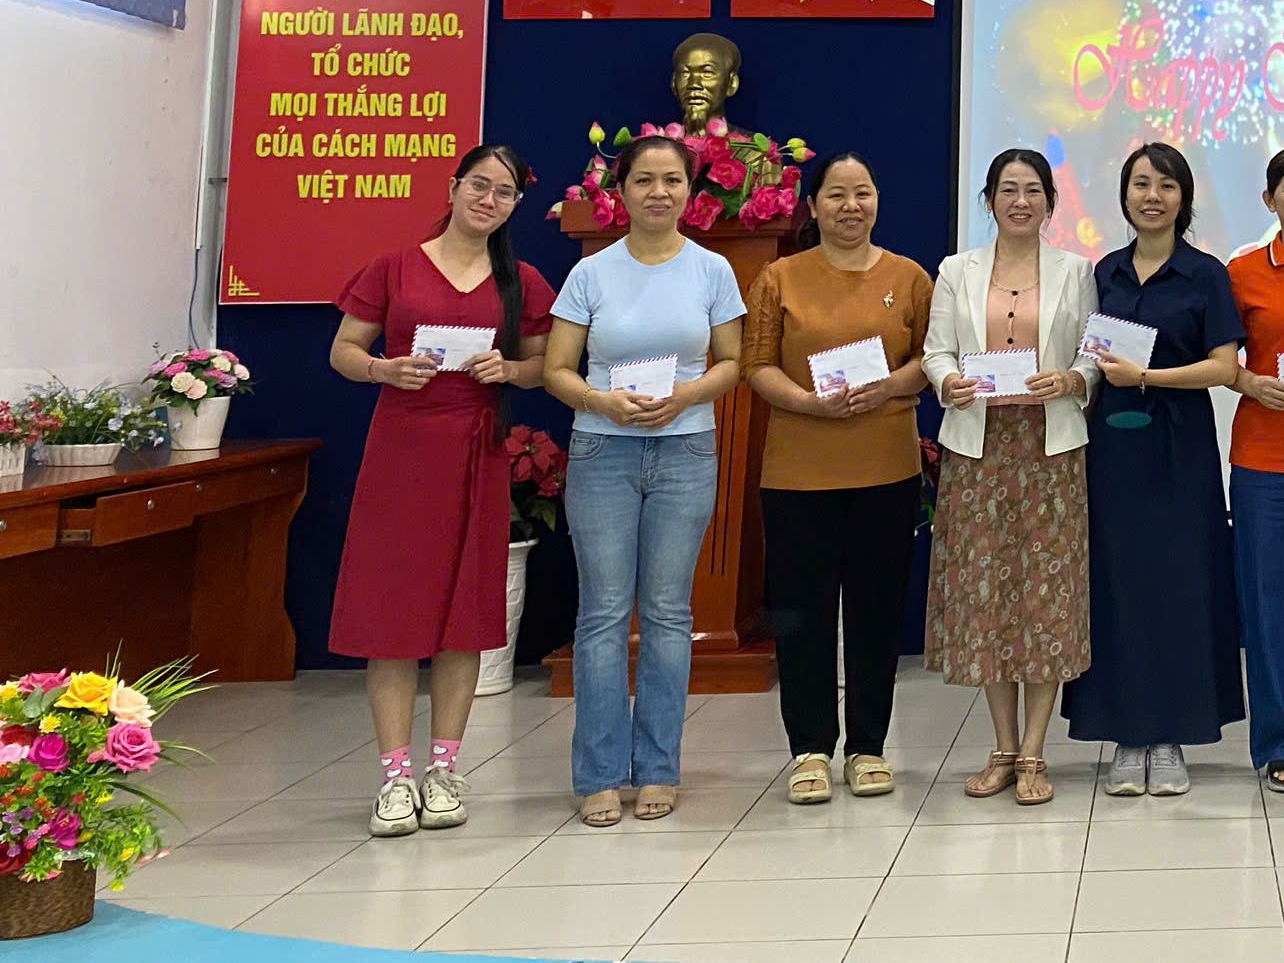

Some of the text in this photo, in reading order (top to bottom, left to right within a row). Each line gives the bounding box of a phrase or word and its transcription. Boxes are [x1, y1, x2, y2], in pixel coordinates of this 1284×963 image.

[260, 5, 464, 41] NGƯỜI LÃNH ĐẠO,
[312, 43, 411, 76] TỔ CHỨC
[1073, 17, 1246, 141] Happy
[270, 85, 447, 122] MỌI THẮNG LỢI
[256, 125, 456, 162] CỦA CÁCH MẠNG
[297, 169, 411, 202] VIỆT NAM
